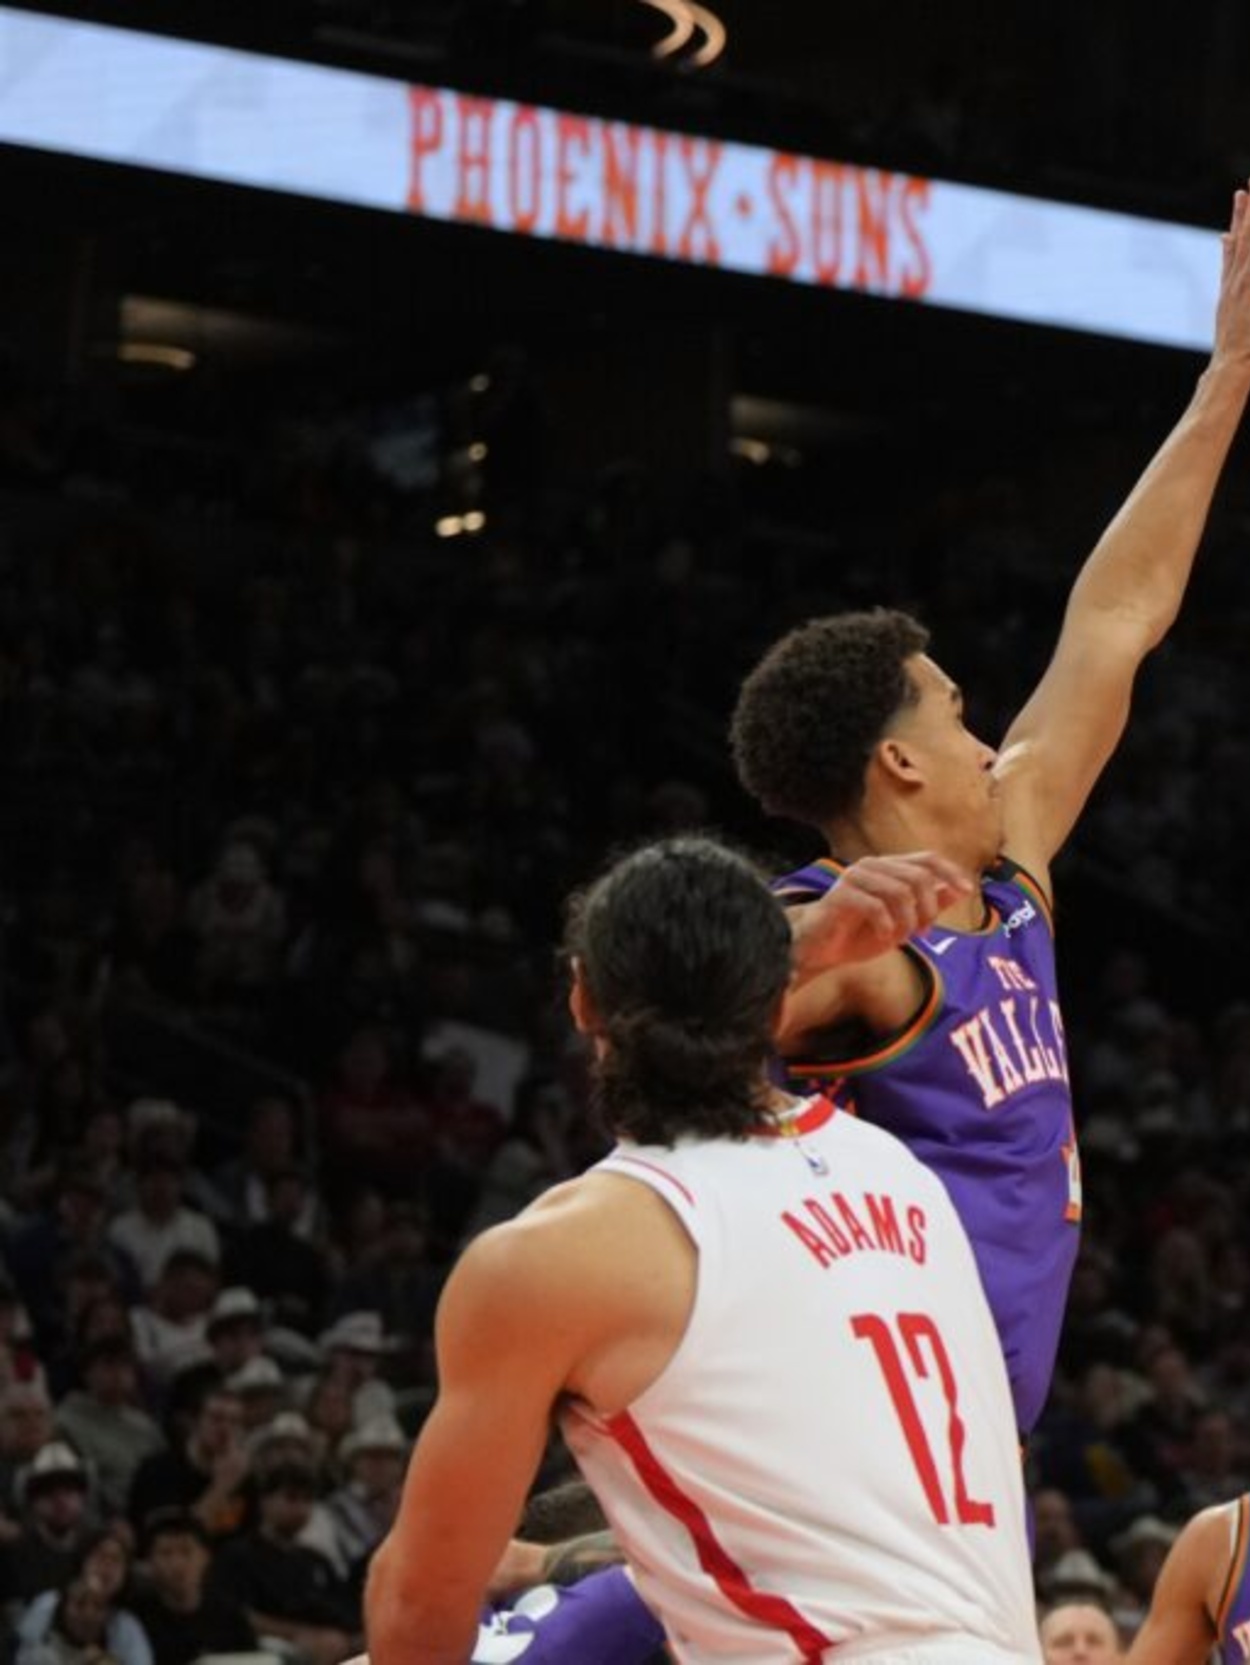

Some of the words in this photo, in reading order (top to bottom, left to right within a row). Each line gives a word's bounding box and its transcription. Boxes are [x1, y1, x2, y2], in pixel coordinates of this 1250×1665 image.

[407, 84, 722, 266] PHOENIX
[768, 151, 931, 298] SUNS
[780, 1192, 927, 1269] ADAMS
[849, 1312, 997, 1528] 12
